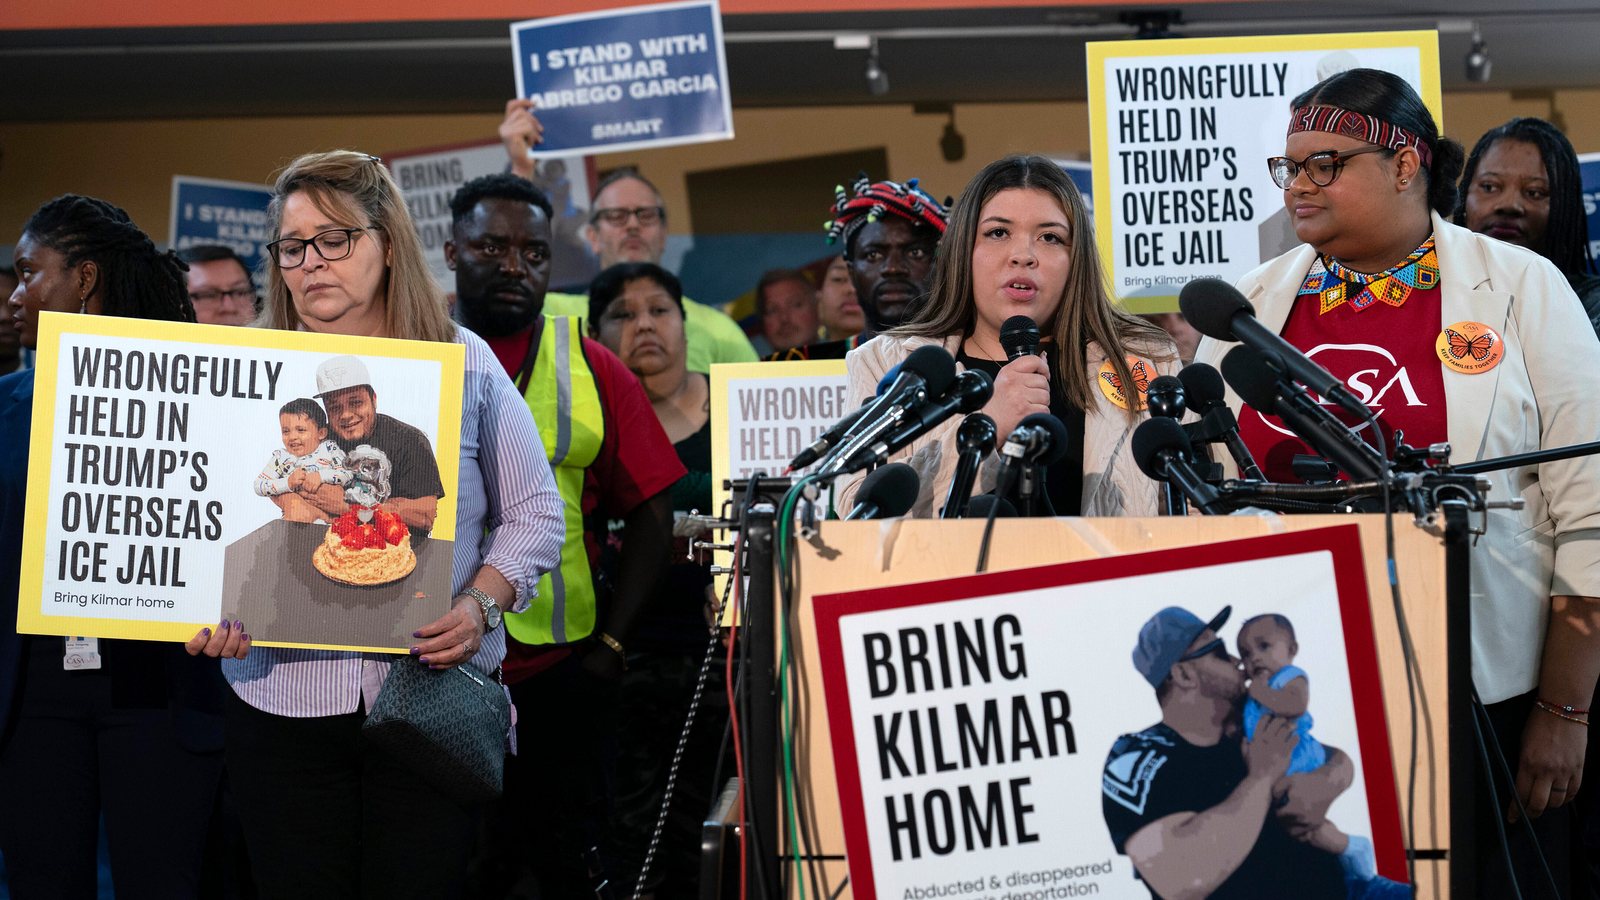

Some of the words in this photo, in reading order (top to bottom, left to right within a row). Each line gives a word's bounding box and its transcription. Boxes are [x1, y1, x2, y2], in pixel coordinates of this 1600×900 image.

[530, 53, 540, 72] I
[547, 42, 632, 69] STAND
[639, 33, 708, 59] WITH
[573, 58, 668, 86] KILMAR
[630, 73, 718, 99] GARCIA
[1116, 63, 1288, 102] WRONGFULLY
[591, 118, 663, 140] SMART
[1119, 108, 1182, 143] HELD
[1190, 106, 1217, 141] IN
[401, 158, 463, 191] BRING
[1119, 147, 1237, 184] TRUMP'S
[1123, 187, 1254, 226] OVERSEAS
[1125, 232, 1165, 267] ICE
[1173, 230, 1229, 265] JAIL
[1124, 276, 1152, 288] Bring
[1155, 274, 1188, 285] Kilmar
[72, 346, 283, 401] WRONGFULLY
[1440, 348, 1450, 360] KEEP
[1448, 359, 1474, 370] FAMILIES
[1475, 353, 1498, 369] TOGETHER
[738, 386, 846, 422] WRONGF
[1111, 392, 1124, 402] KEEP
[68, 395, 146, 440] HELD
[156, 400, 189, 442] IN
[740, 426, 801, 461] HELD
[64, 443, 208, 492] TRUMP'S
[61, 491, 223, 541] OVERSEAS
[58, 540, 108, 583] ICE
[117, 545, 187, 588] JAIL
[54, 592, 88, 608] Bring
[91, 593, 133, 607] Kilmar
[136, 596, 175, 609] home
[863, 614, 1028, 699] BRING
[874, 690, 1077, 780] KILMAR
[885, 777, 1040, 862] HOME
[904, 876, 985, 900] Abducted
[989, 875, 1000, 890] &
[1006, 860, 1113, 887] disappeared
